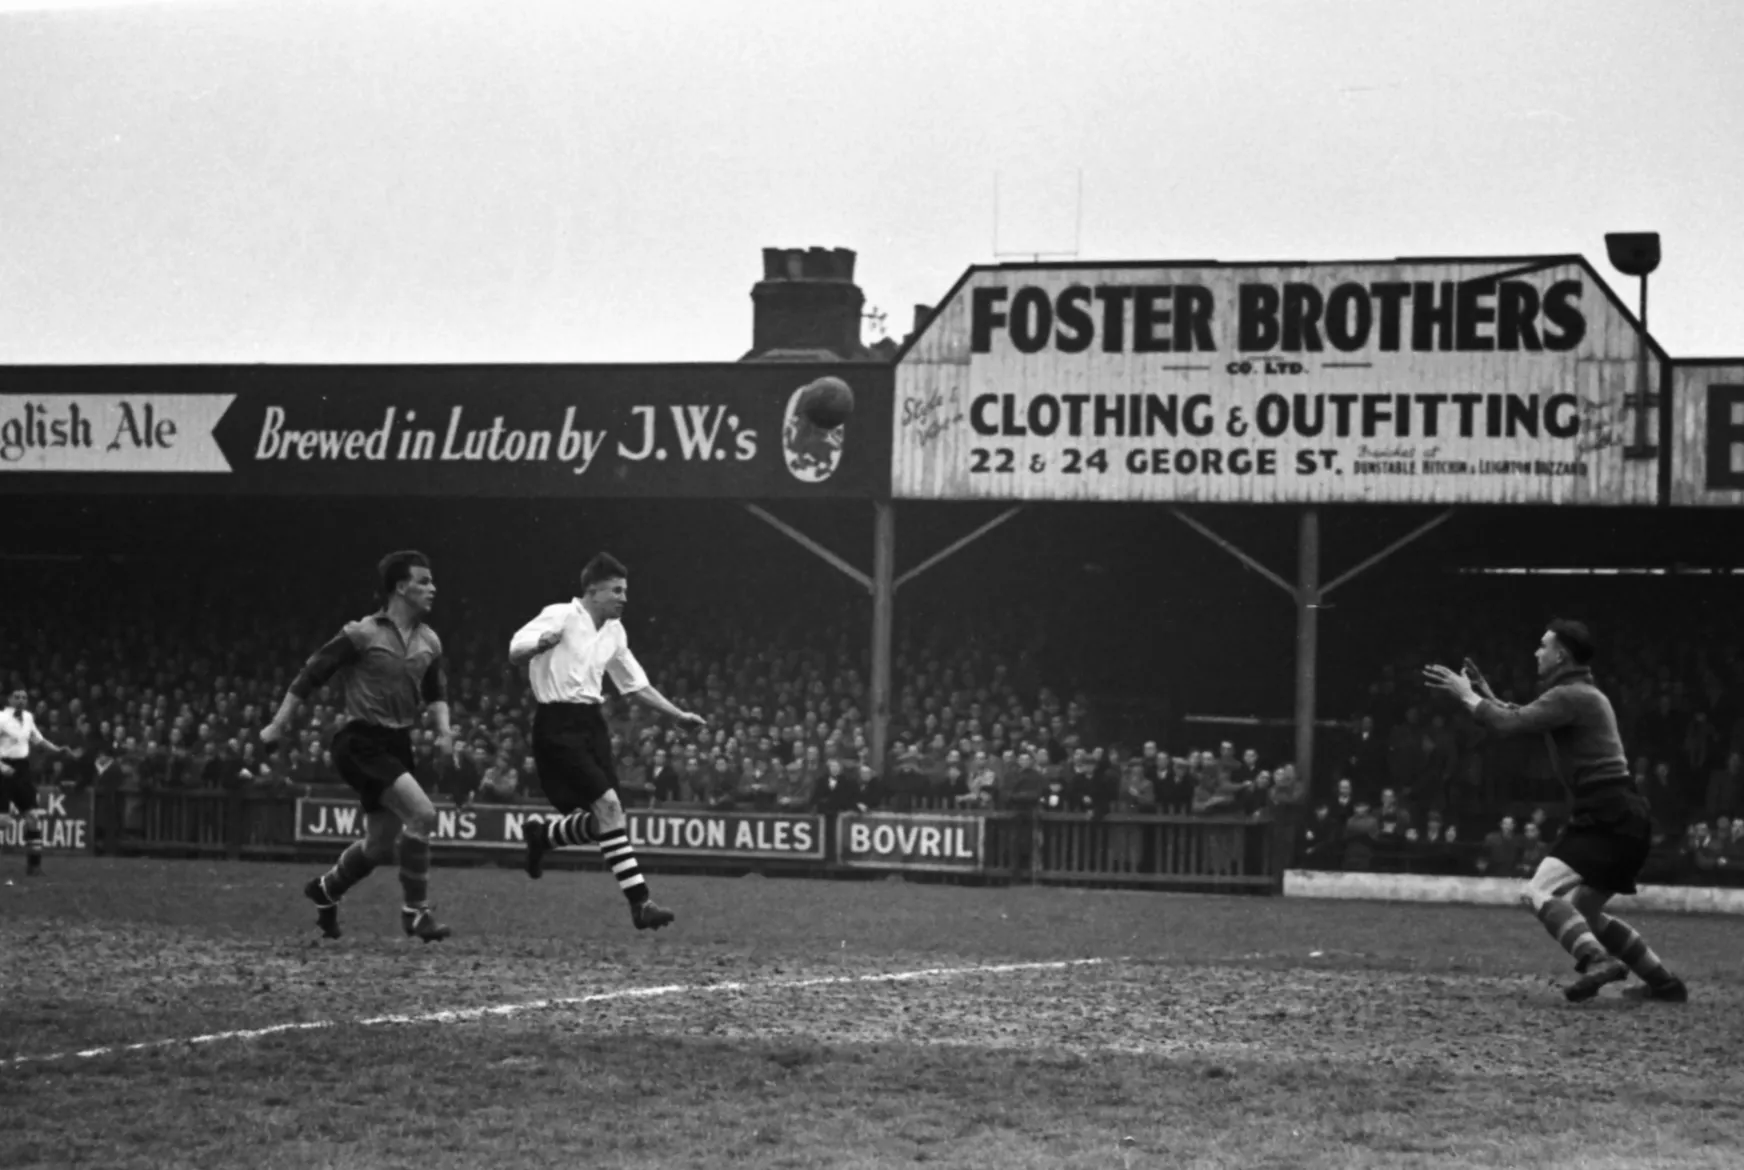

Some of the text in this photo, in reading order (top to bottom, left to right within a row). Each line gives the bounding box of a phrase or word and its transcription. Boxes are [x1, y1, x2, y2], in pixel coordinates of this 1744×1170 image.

[969, 280, 1587, 354] FOSTER BROTHERS
[106, 400, 177, 452] Ale
[970, 393, 1214, 438] CLOTHING
[1226, 406, 1248, 438] &
[1256, 391, 1579, 439] OUTFITTING
[255, 406, 396, 461] Brewed
[397, 410, 436, 460] in
[440, 405, 552, 462] Luton
[556, 405, 607, 475] by
[970, 447, 1343, 476] 22 & 24 GEORGE ST.
[308, 806, 361, 836] J.W.
[630, 816, 725, 850] LUTON
[733, 818, 812, 851] ALES
[850, 823, 974, 859] BOVRIL
